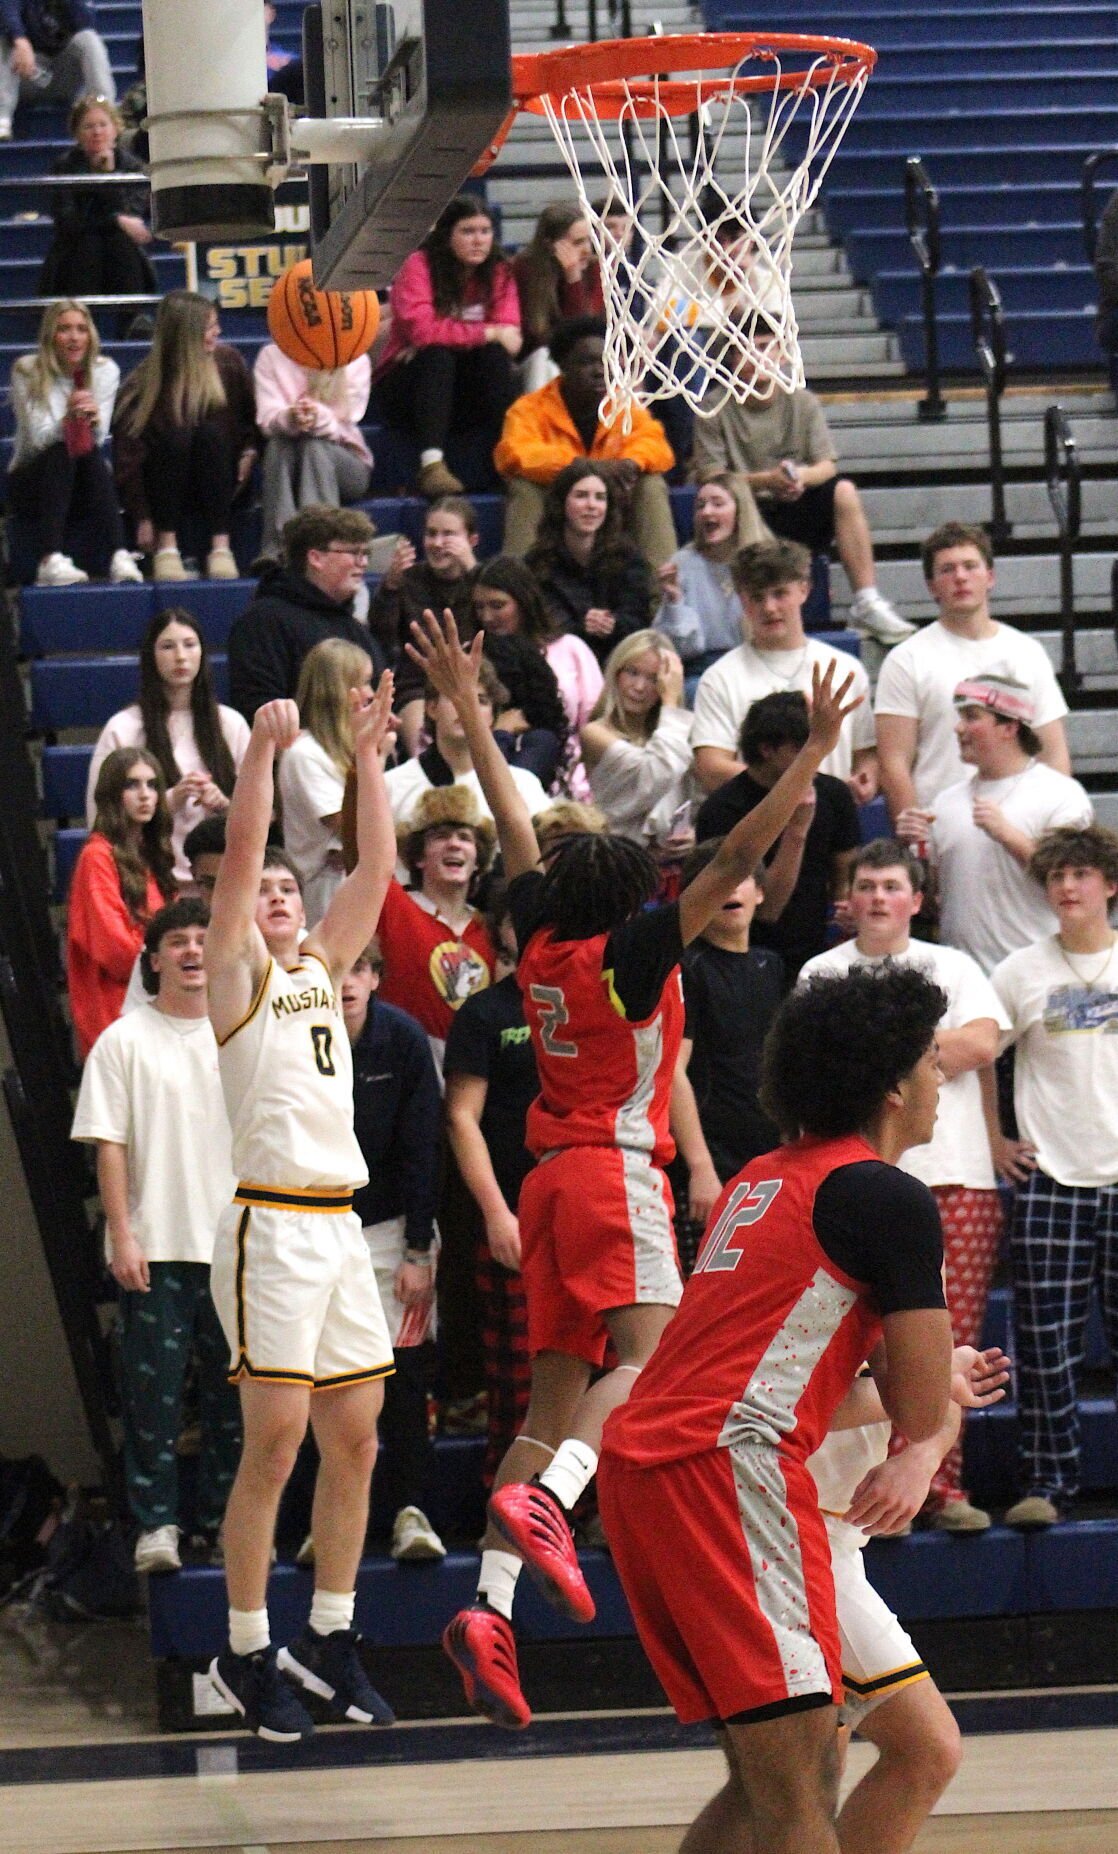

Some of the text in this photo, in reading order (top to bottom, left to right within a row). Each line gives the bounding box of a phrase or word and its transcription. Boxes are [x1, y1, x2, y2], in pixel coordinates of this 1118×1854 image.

[207, 245, 308, 279] STU
[271, 987, 338, 1019] MUSTA
[529, 983, 579, 1058] 2
[310, 1023, 336, 1076] 0
[691, 1179, 783, 1275] 12
